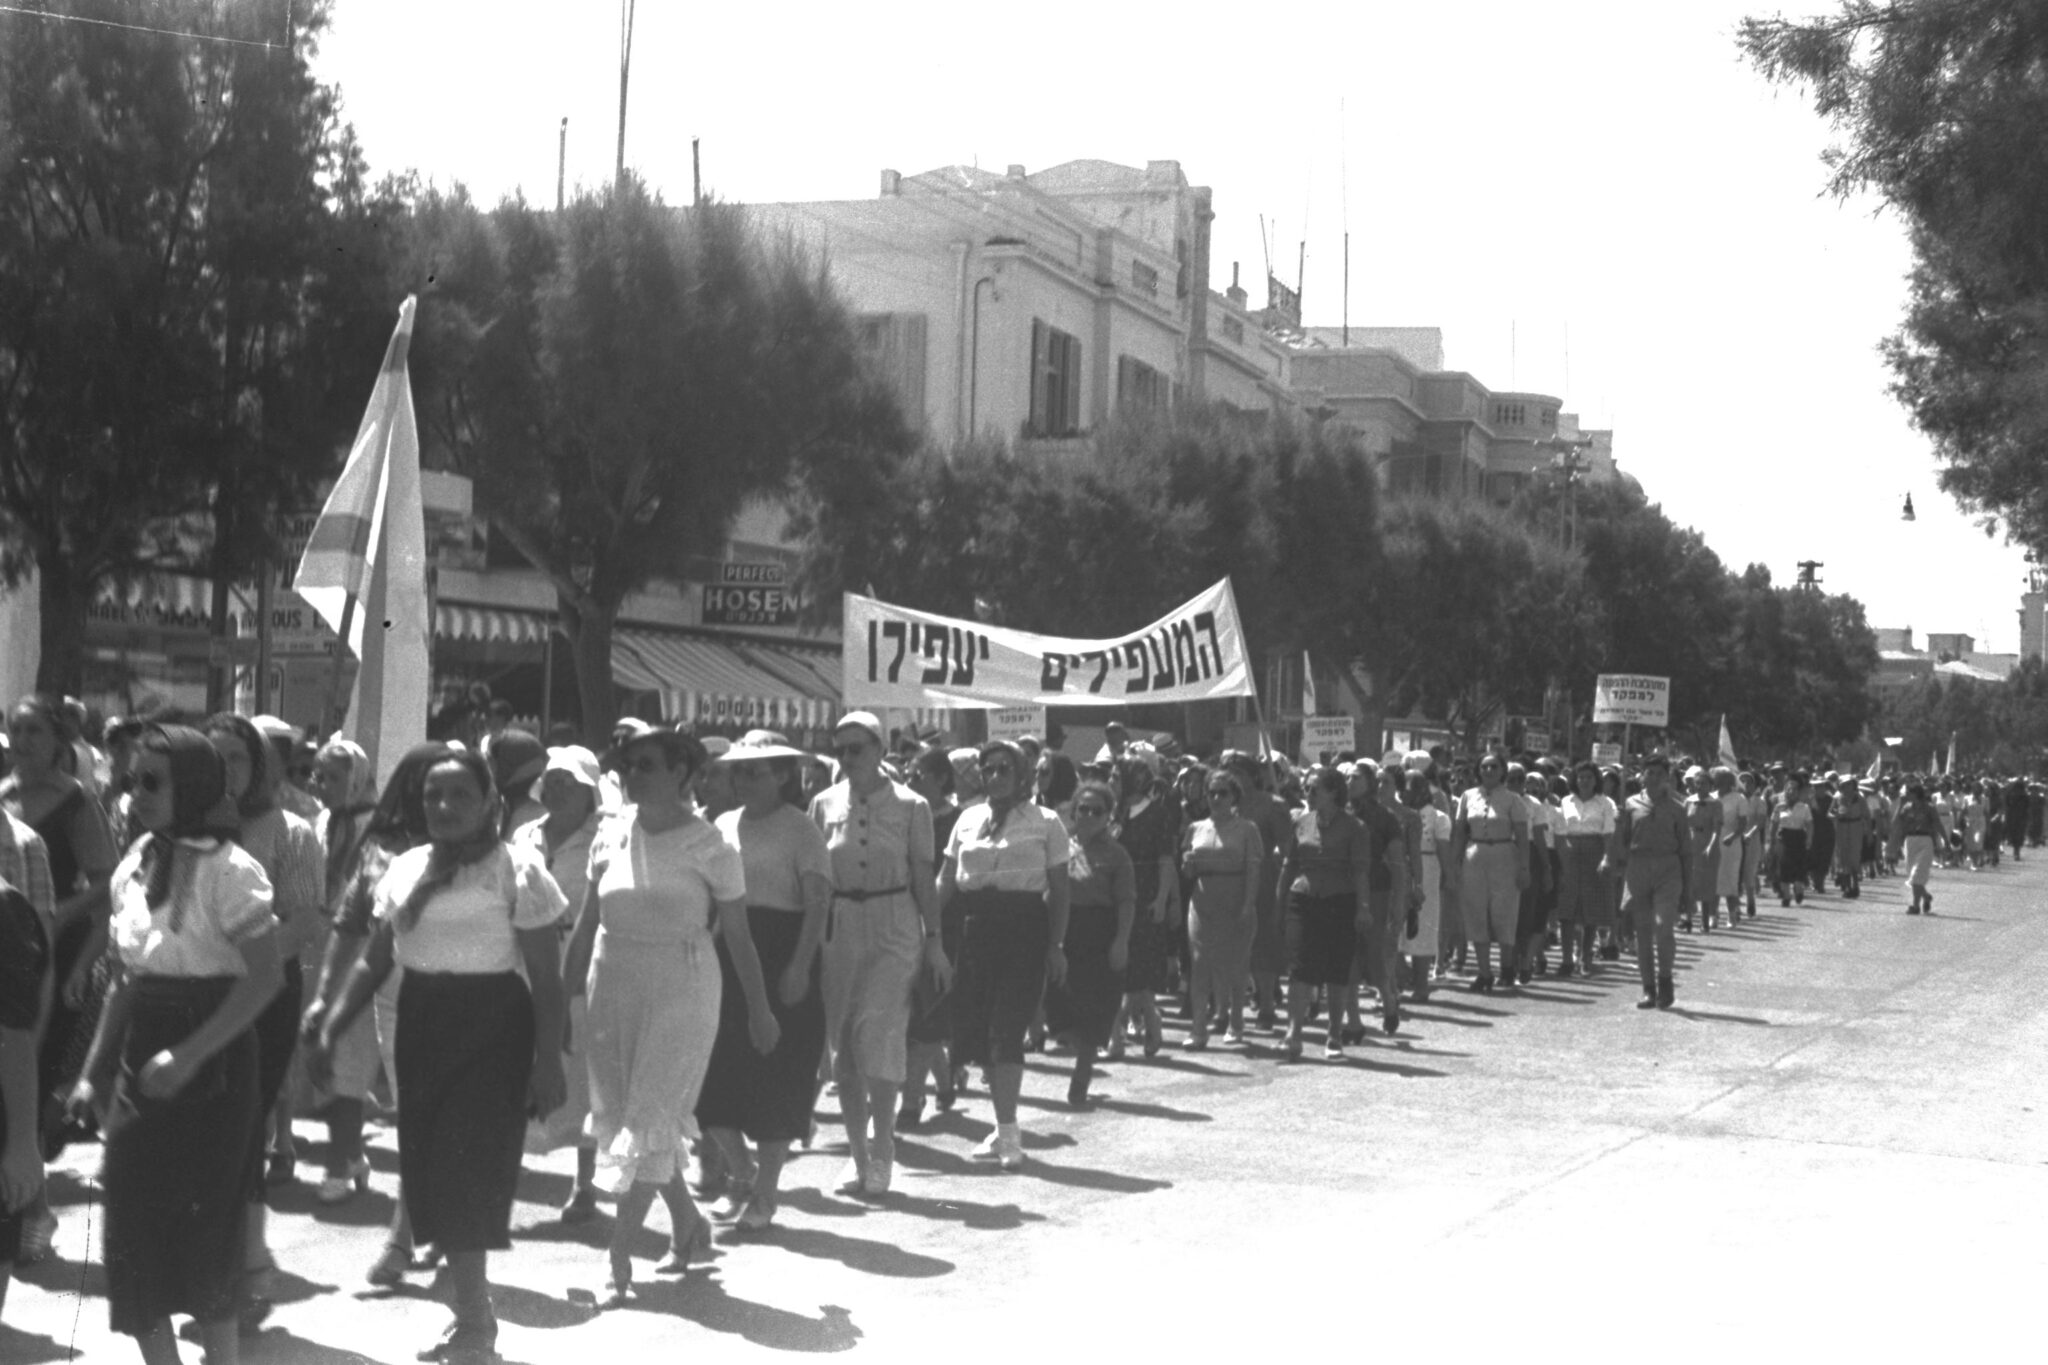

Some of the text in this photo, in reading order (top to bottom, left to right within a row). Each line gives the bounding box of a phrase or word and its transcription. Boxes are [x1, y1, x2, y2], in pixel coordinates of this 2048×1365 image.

[705, 588, 799, 612] HOSEN
[867, 610, 1224, 694] המעפילים יעפילו
[1612, 690, 1655, 702] למפקד
